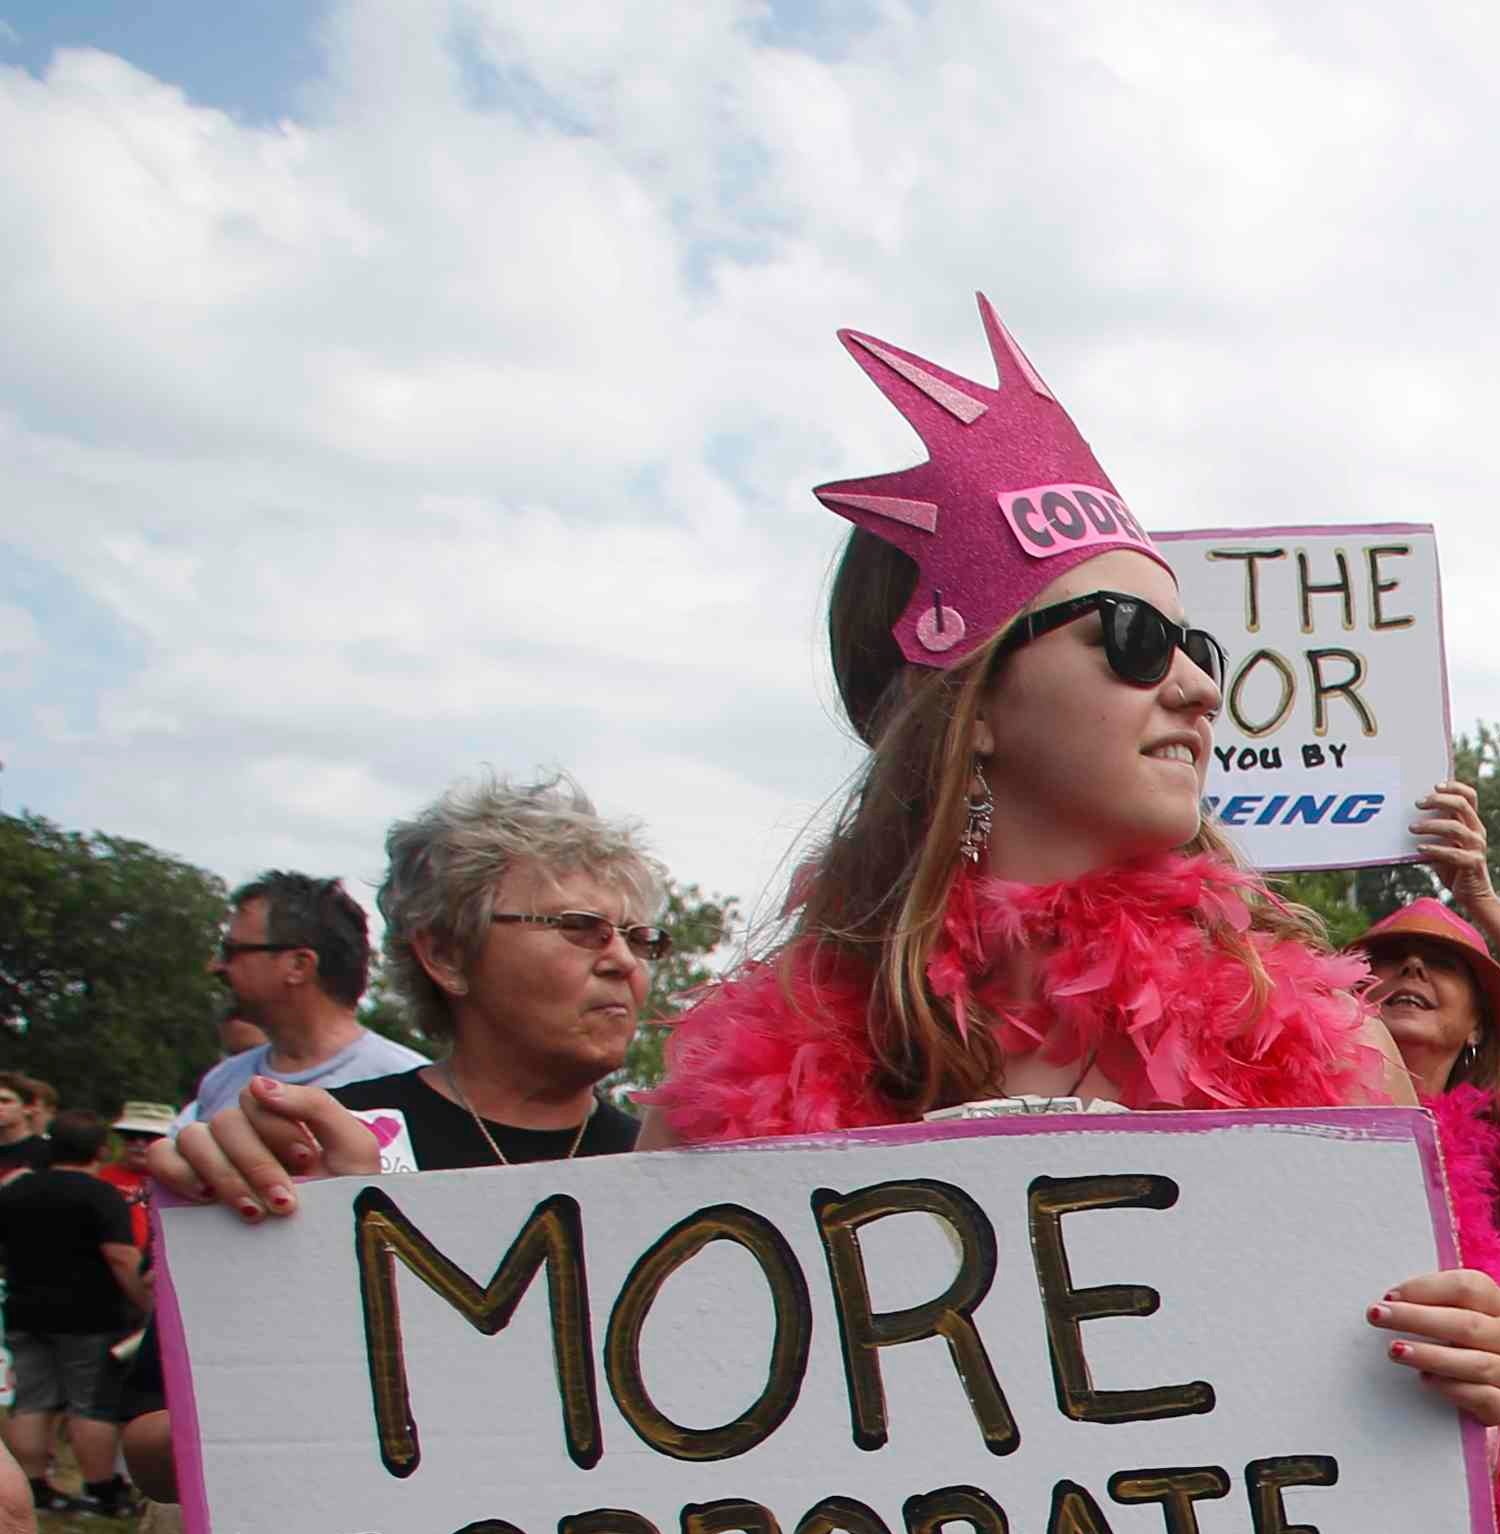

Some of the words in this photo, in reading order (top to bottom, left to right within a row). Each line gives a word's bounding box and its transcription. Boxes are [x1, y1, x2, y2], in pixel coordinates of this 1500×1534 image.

[1206, 544, 1416, 634] THE
[1226, 647, 1379, 738] OR
[1214, 745, 1283, 772] YOU
[1301, 743, 1347, 769] BY
[354, 1173, 1216, 1479] MORE
